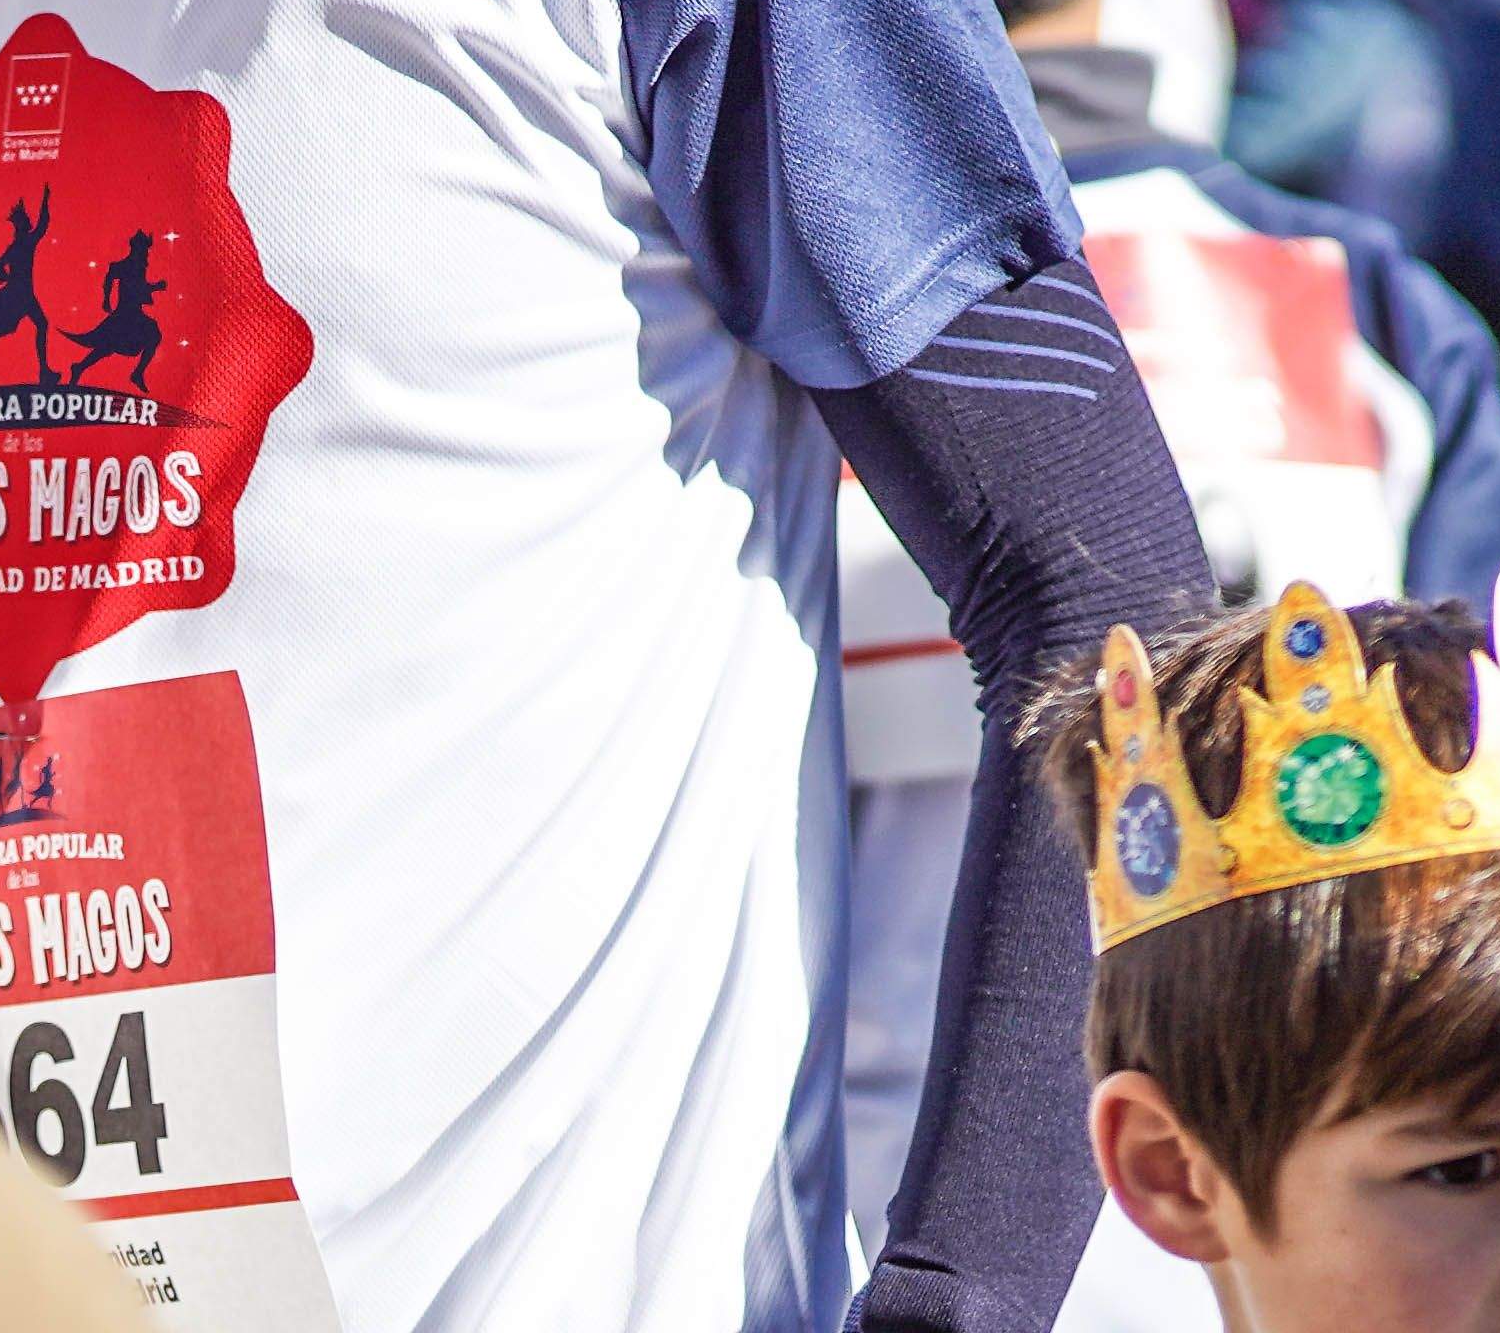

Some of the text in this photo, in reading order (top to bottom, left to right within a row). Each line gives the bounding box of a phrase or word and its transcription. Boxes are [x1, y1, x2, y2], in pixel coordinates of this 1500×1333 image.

[29, 393, 159, 427] POPULAR
[28, 450, 202, 543] MAGOS
[34, 566, 65, 592] DE
[70, 555, 205, 591] MADRID
[21, 833, 125, 861] POPULAR
[25, 878, 171, 986] MAGOS
